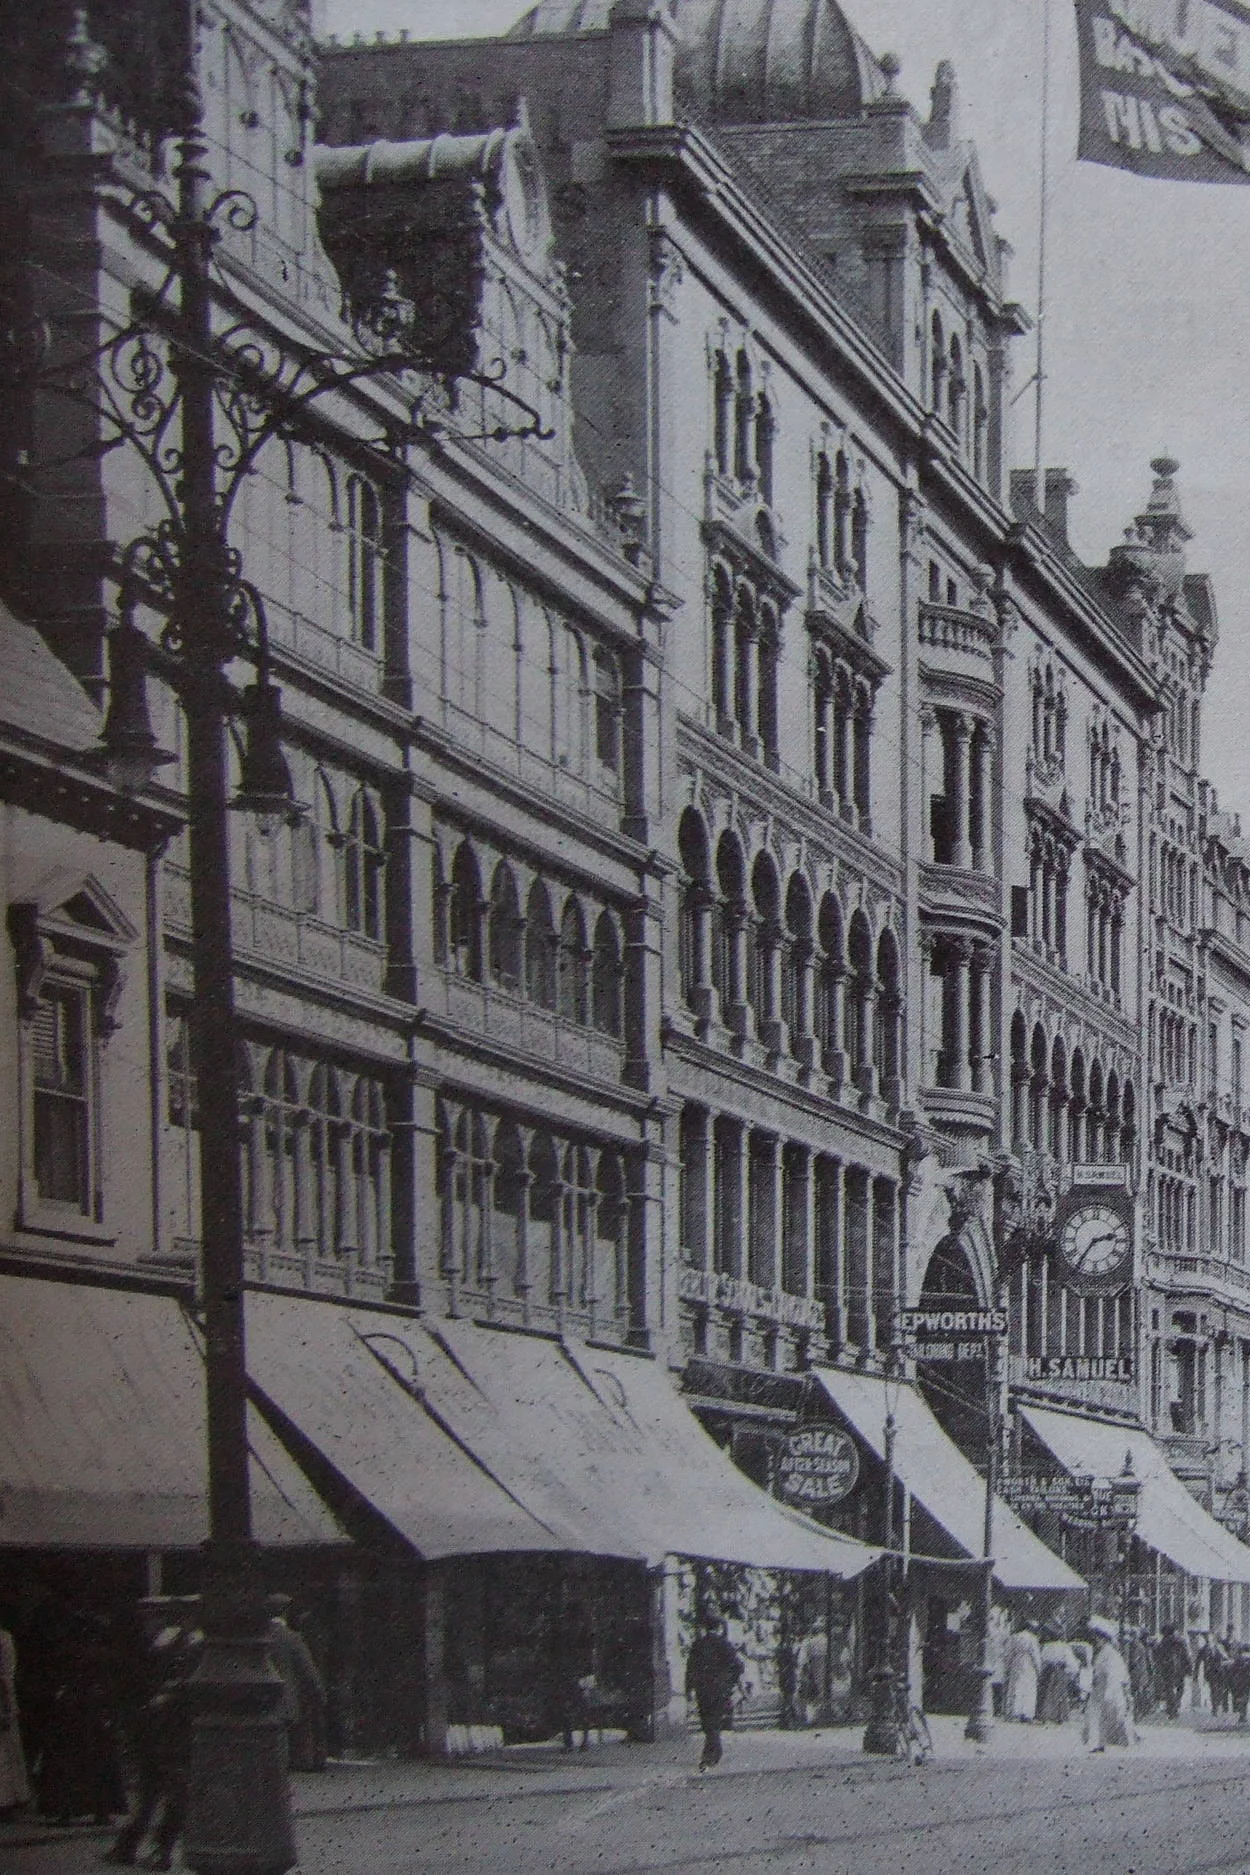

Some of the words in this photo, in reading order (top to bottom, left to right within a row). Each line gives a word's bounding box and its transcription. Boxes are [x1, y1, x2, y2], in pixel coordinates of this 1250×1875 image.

[1048, 1356, 1133, 1381] SAMUEL
[788, 1430, 847, 1457] GREAT
[783, 1472, 845, 1499] SALE
